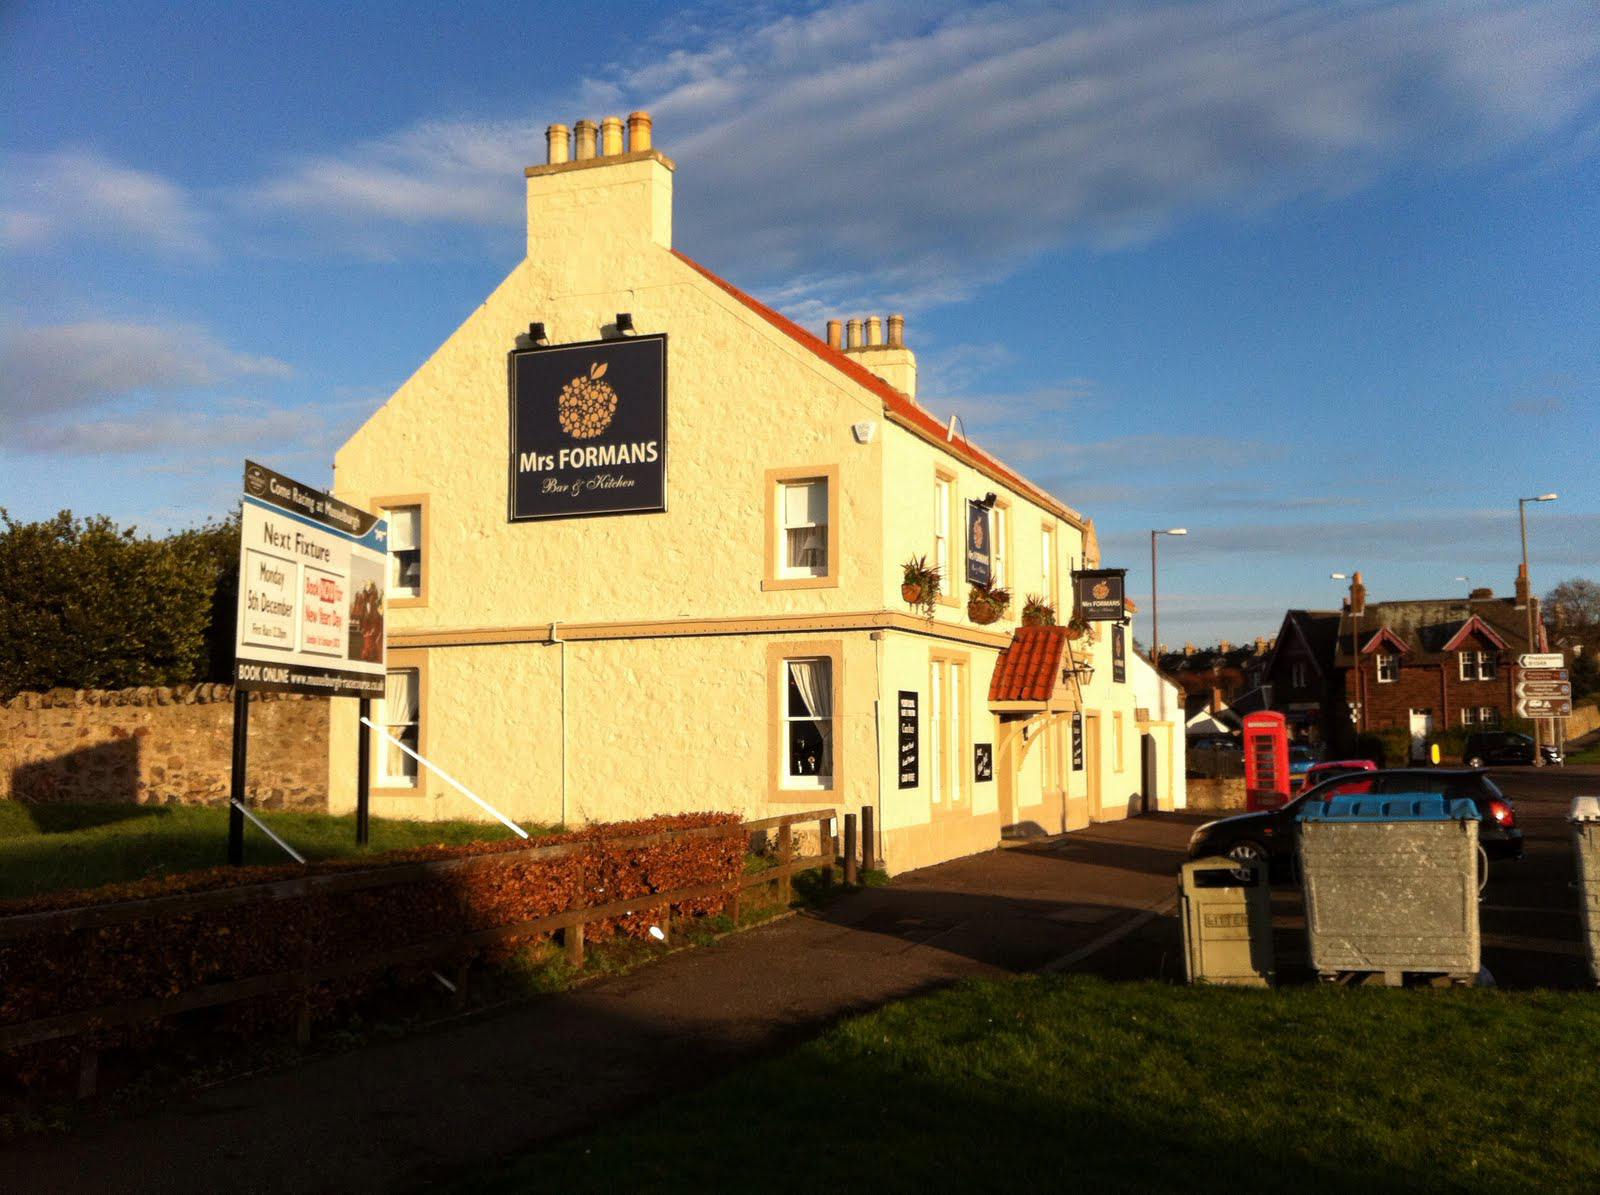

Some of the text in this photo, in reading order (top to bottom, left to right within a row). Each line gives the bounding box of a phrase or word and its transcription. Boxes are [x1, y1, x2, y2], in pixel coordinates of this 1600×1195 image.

[519, 441, 658, 473] Mrs FORMANS
[270, 478, 291, 499] Come
[293, 487, 315, 513] Racing
[316, 502, 324, 513] at
[541, 474, 635, 497] Bar & Kitchen
[264, 522, 330, 562] Next Fixture
[260, 562, 285, 592] Monday
[248, 589, 293, 617] 5th December
[238, 664, 261, 681] BOOK
[262, 667, 289, 684] ONLINE
